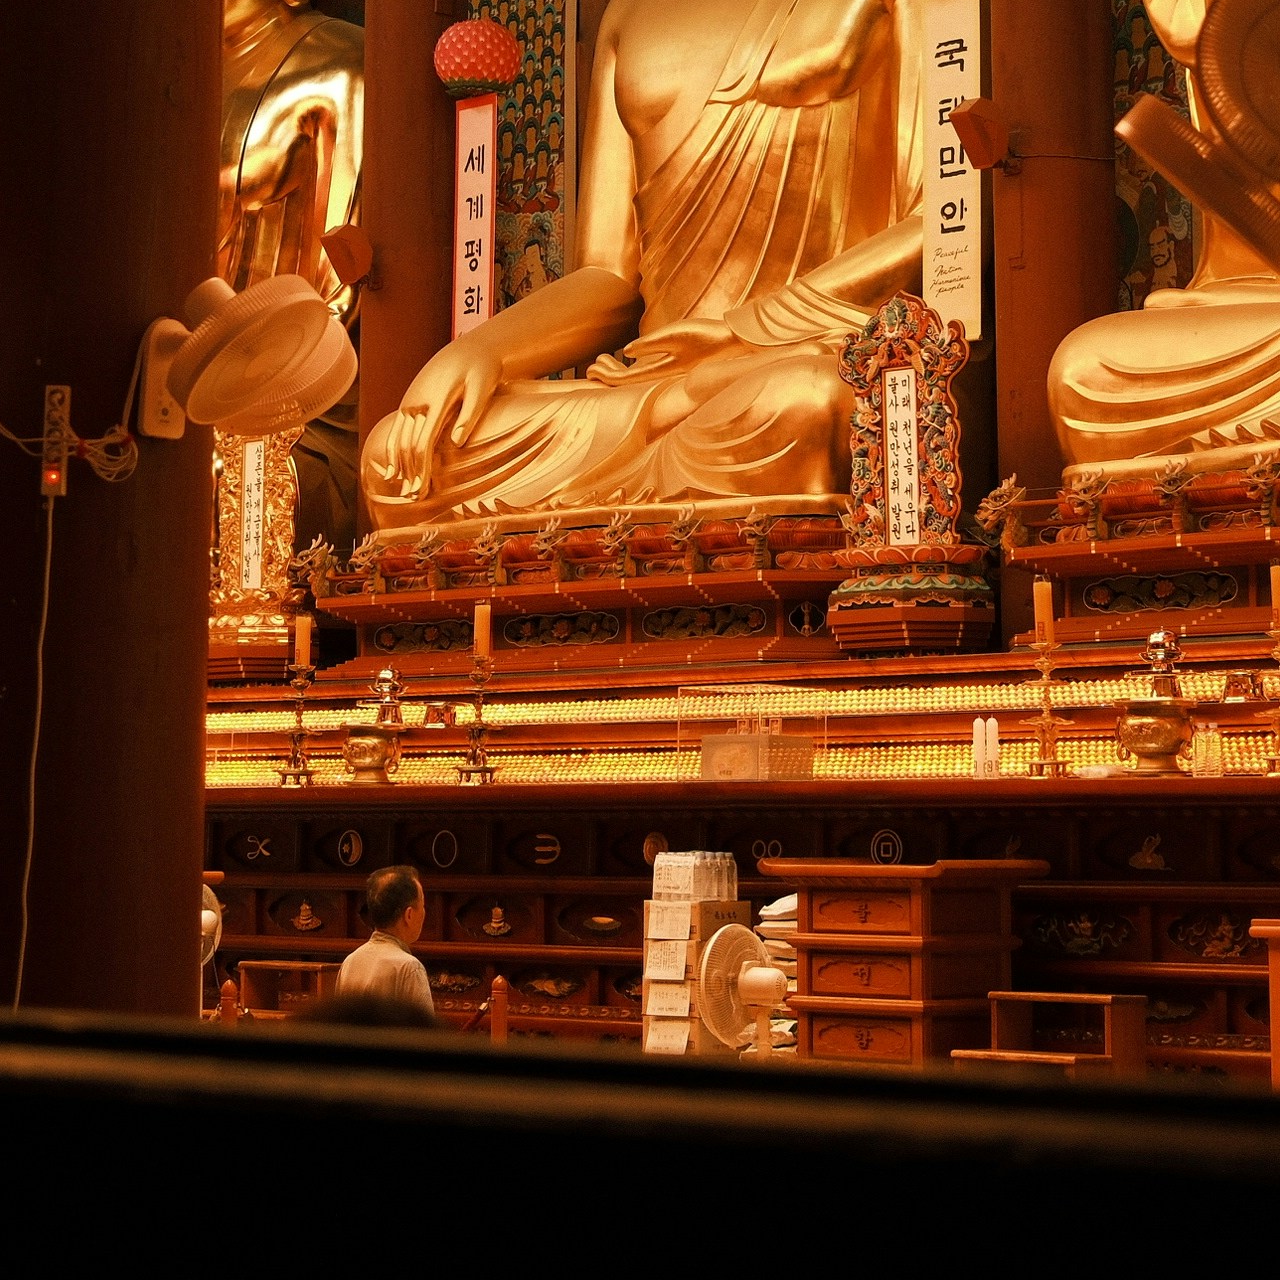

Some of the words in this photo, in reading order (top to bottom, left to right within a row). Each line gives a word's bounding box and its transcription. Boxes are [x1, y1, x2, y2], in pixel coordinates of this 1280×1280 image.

[464, 143, 486, 315] 세계평화
[901, 374, 911, 412] 미래
[902, 419, 914, 476] 천년을
[891, 503, 902, 540] 발원
[904, 483, 916, 539] 세우다
